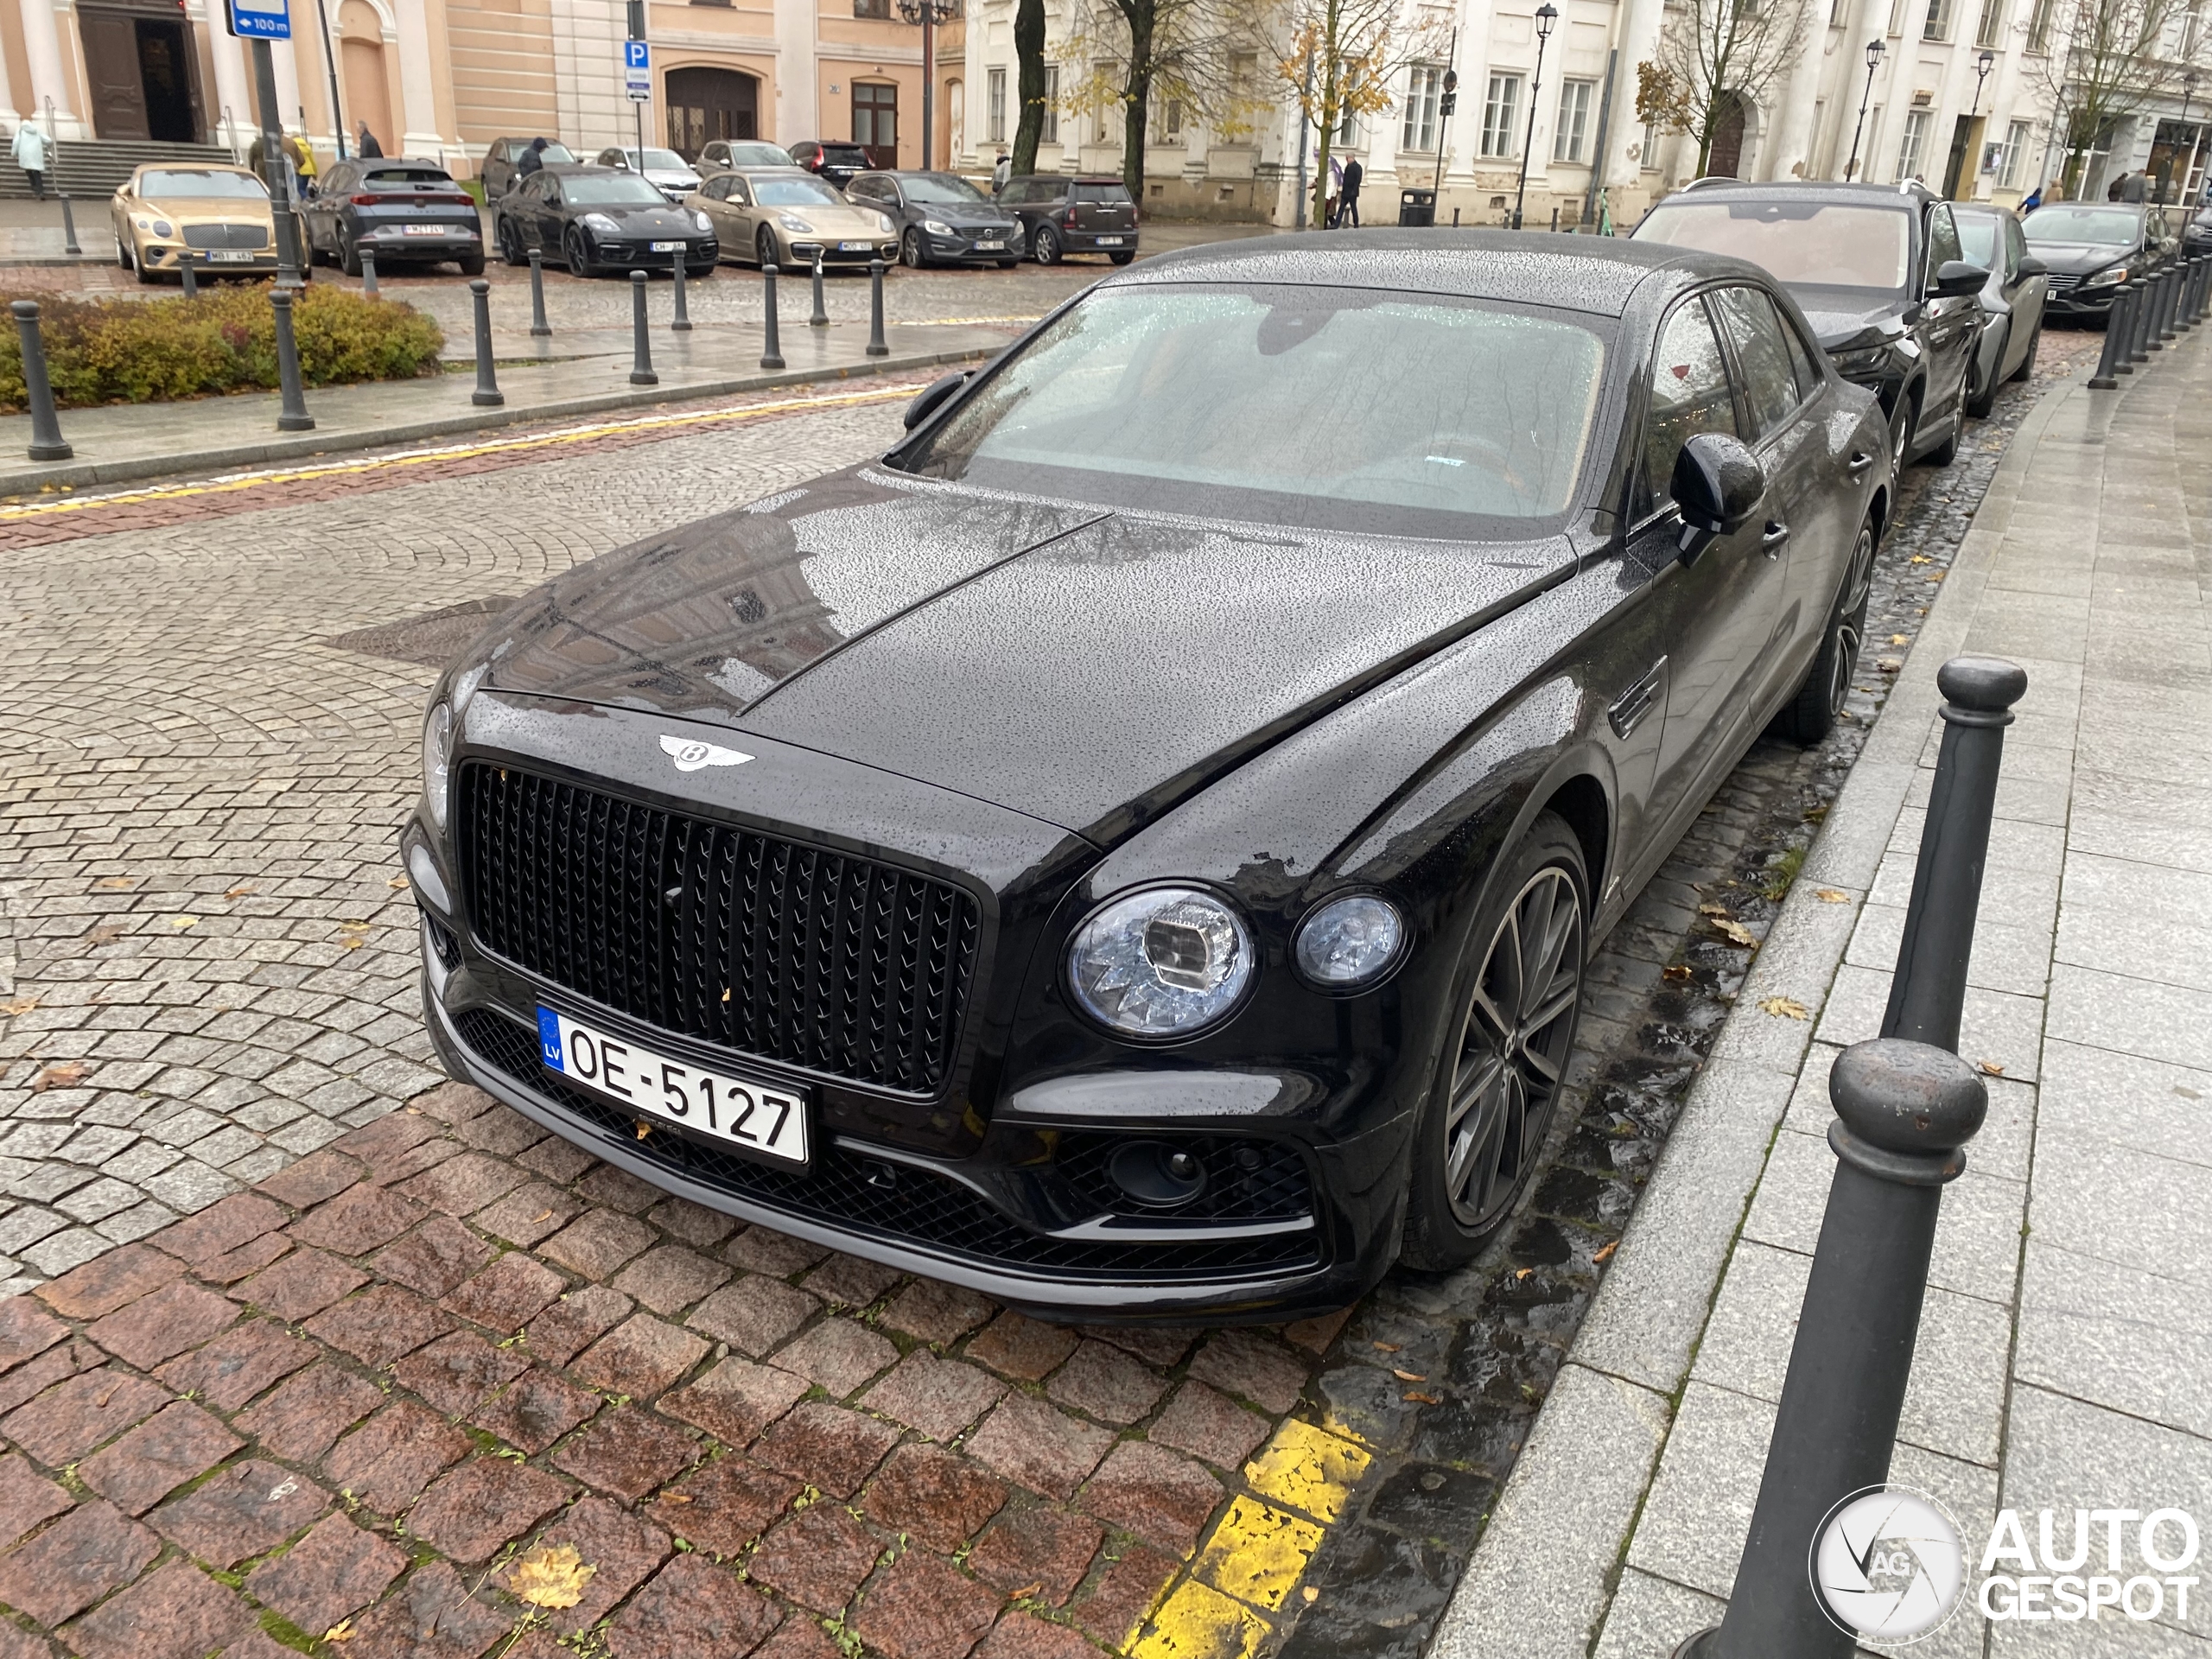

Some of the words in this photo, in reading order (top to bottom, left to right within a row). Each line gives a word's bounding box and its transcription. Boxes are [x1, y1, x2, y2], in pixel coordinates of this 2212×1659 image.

[253, 18, 275, 31] 100
[276, 23, 288, 32] m
[631, 44, 645, 66] P
[680, 744, 709, 763] B
[544, 1043, 561, 1061] LV
[569, 1029, 791, 1147] OE-5127
